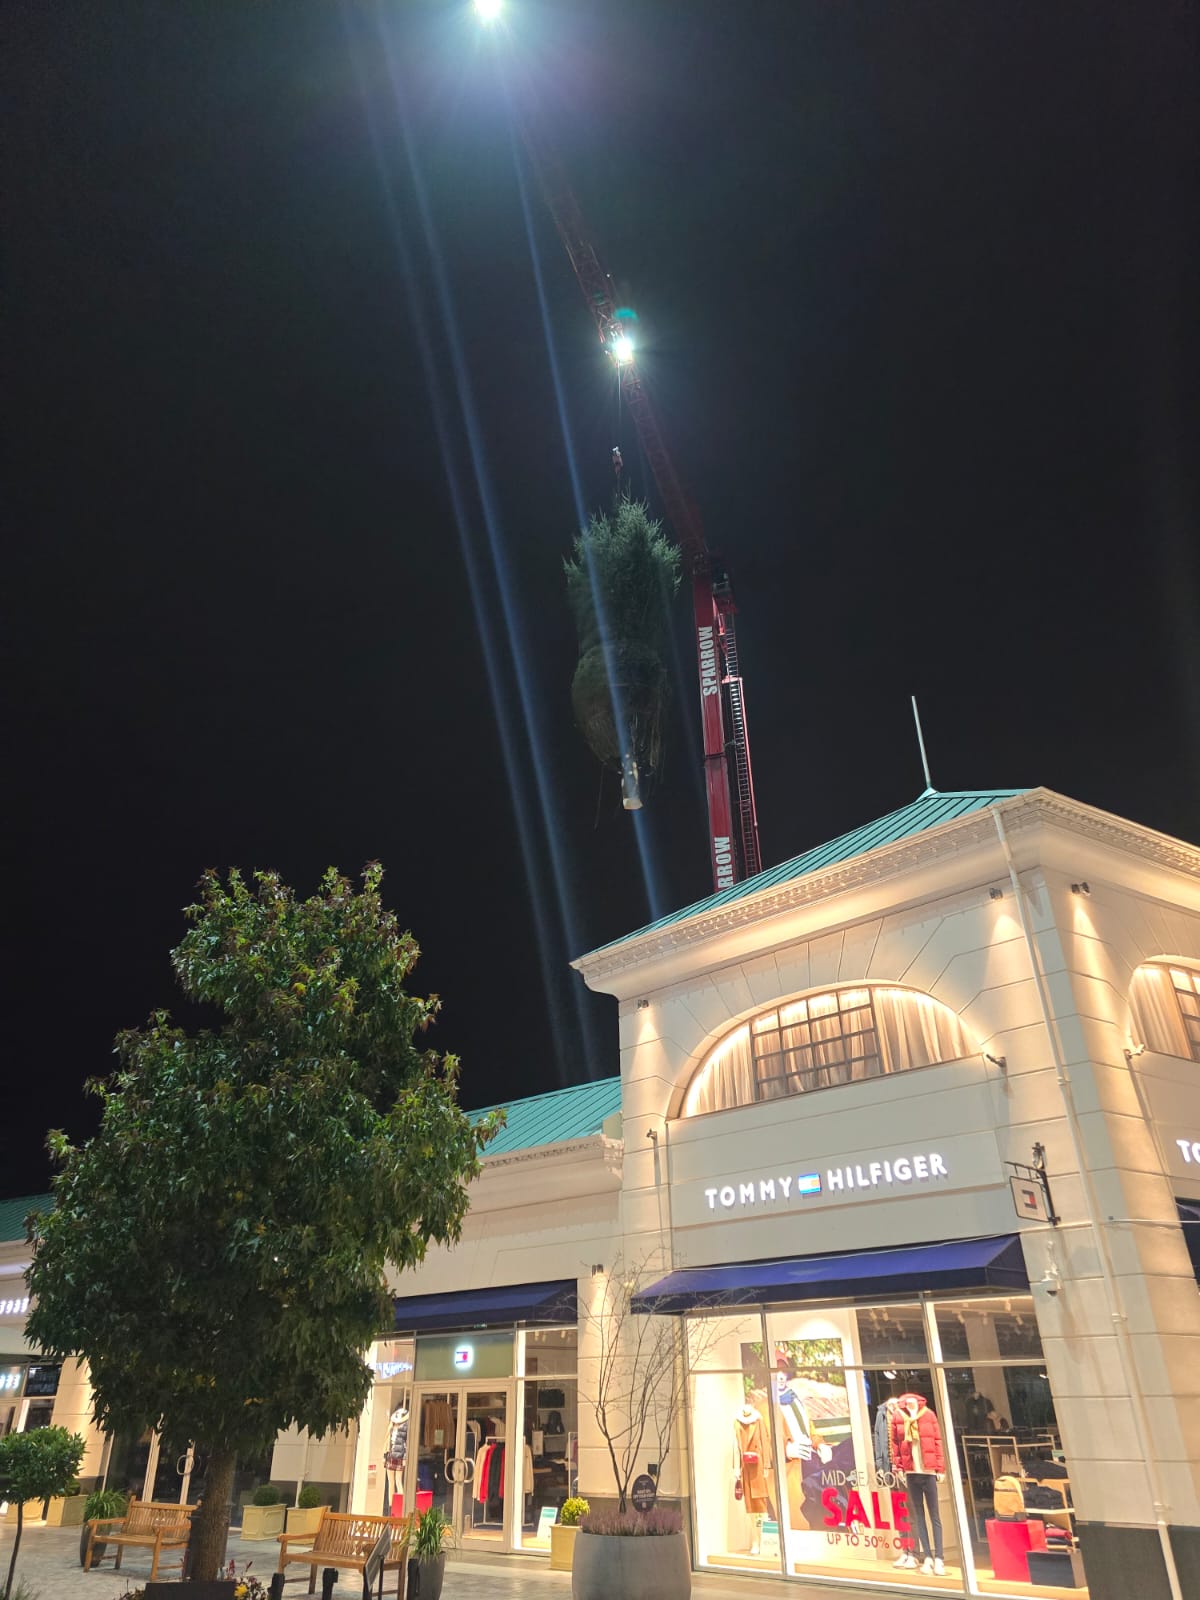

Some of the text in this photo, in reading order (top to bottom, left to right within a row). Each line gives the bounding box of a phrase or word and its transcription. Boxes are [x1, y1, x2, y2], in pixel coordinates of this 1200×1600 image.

[698, 626, 718, 696] SPARROW
[704, 1153, 948, 1208] TOMMY HILFIGER
[821, 1487, 912, 1532] SALE
[827, 1533, 841, 1545] UP
[845, 1534, 859, 1546] TO
[864, 1535, 890, 1549] 50%
